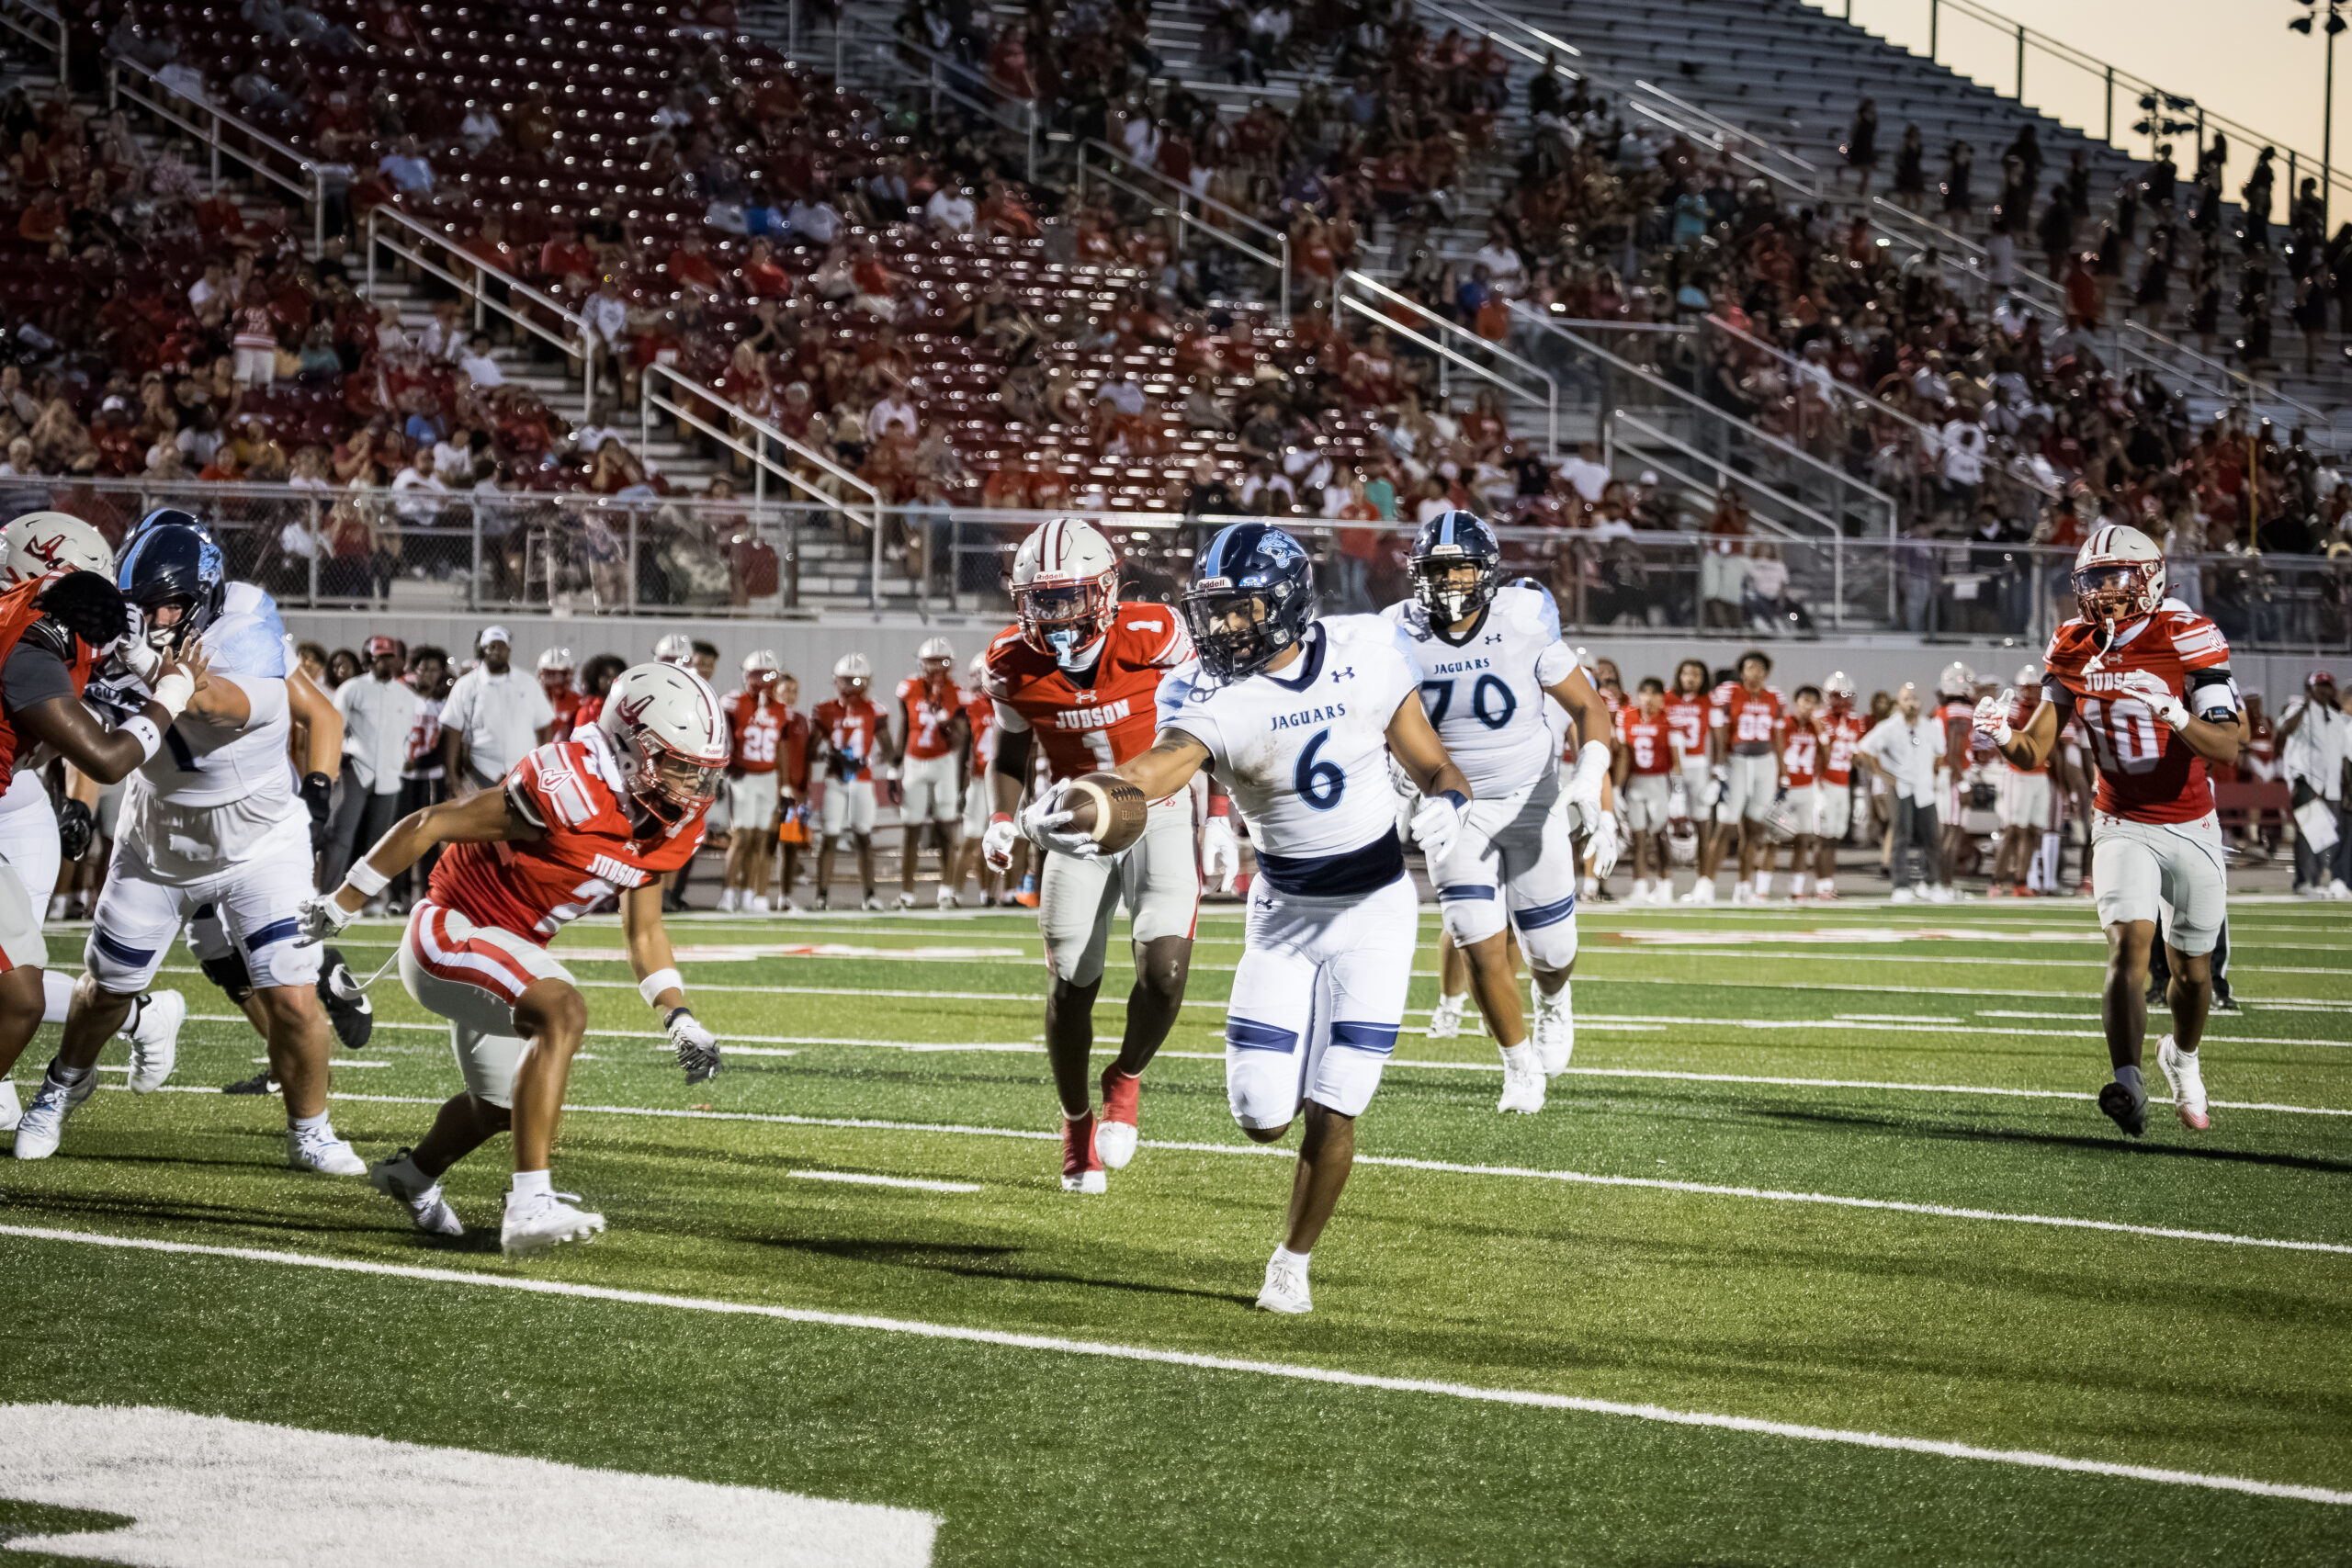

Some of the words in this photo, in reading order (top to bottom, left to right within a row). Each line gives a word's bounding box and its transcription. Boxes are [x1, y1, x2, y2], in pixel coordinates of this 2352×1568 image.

[1433, 658, 1490, 674] JAGUARS
[2084, 671, 2124, 692] JUDS
[1056, 699, 1130, 728] JUDSON
[1271, 703, 1346, 731] JAGUARS
[1421, 672, 1517, 733] 70
[1081, 729, 1116, 772] 1
[2083, 697, 2160, 774] 10
[1292, 726, 1347, 812] 6
[585, 853, 647, 888] JUDSON
